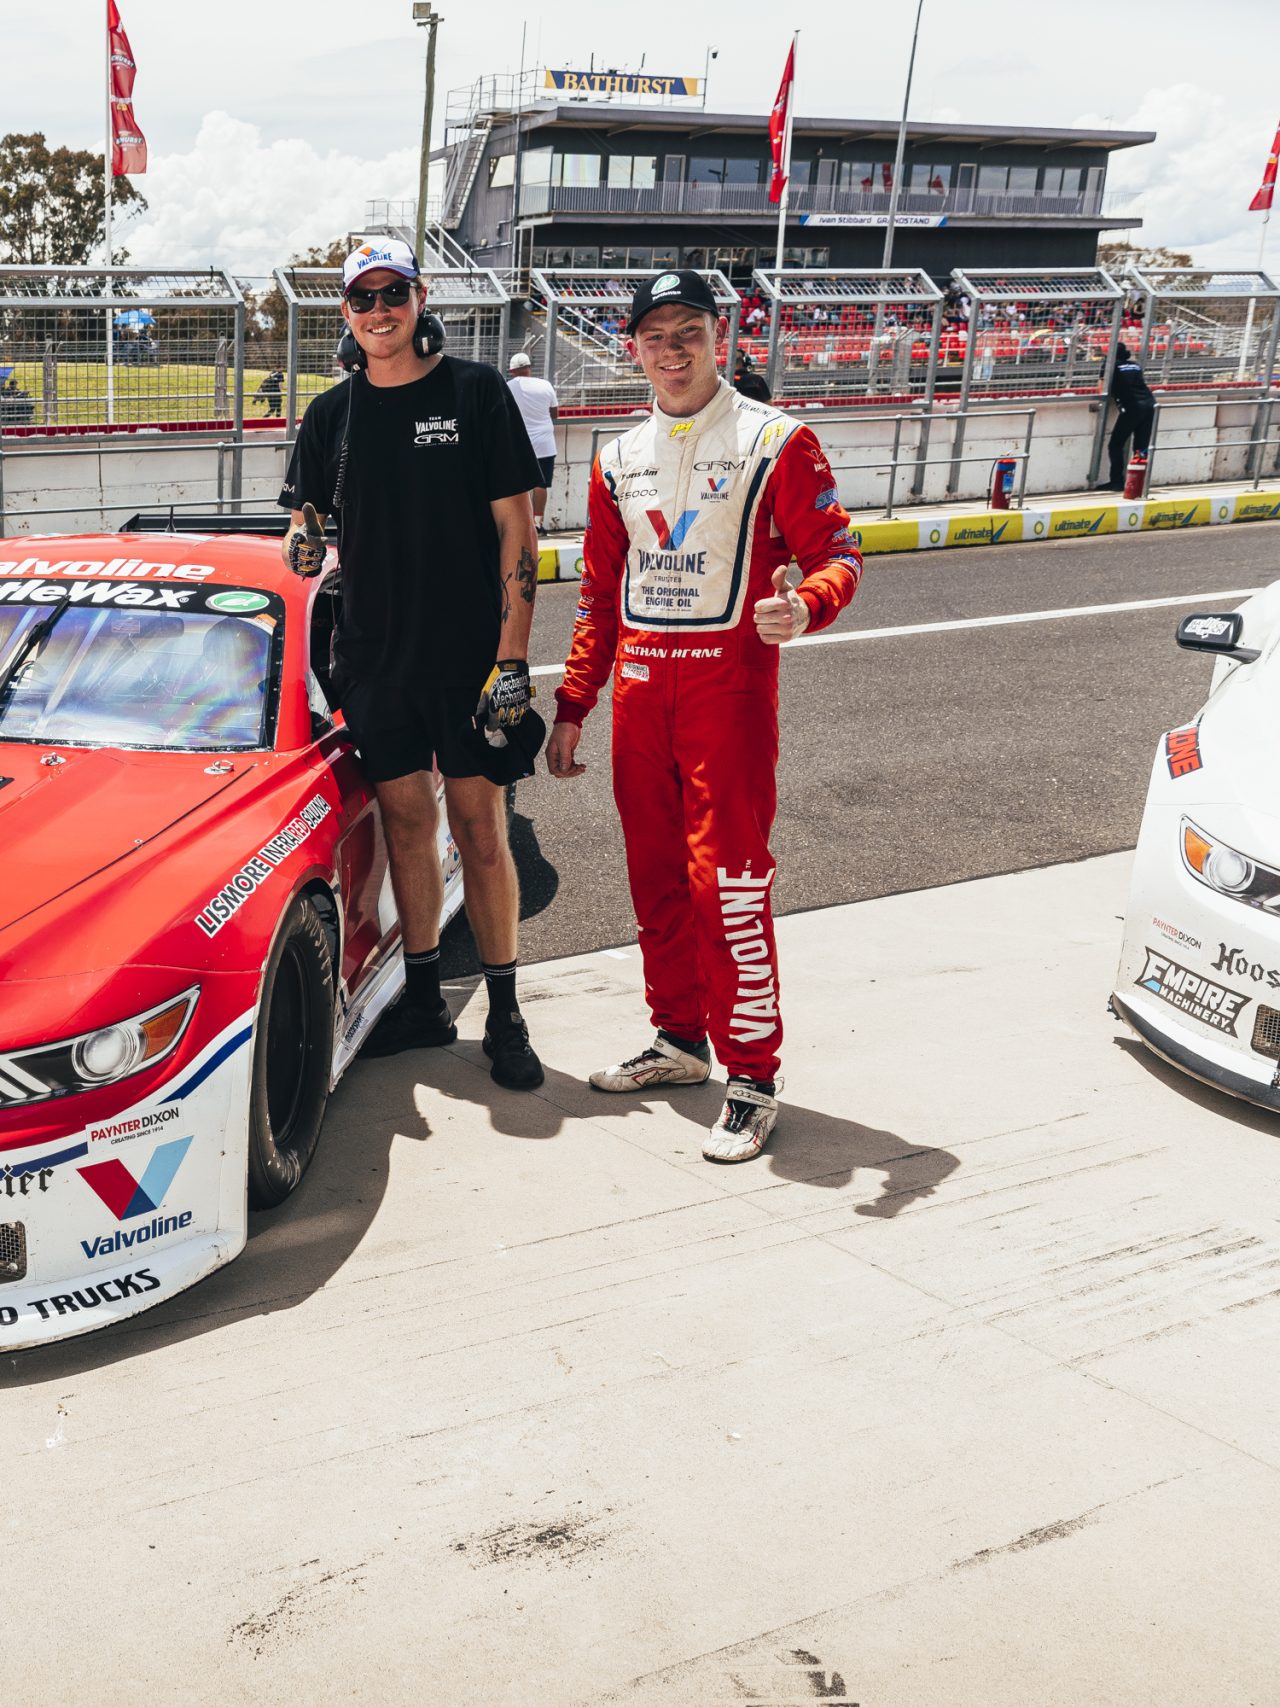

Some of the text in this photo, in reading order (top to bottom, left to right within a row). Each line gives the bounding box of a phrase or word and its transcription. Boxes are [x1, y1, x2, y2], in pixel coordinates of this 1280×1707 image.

[563, 73, 675, 95] BATHURST
[357, 251, 393, 270] VALVOLINE
[415, 418, 458, 434] VALVOLINE
[413, 432, 459, 445] GRM
[693, 460, 746, 472] GRM
[953, 527, 992, 541] ultimate
[1054, 518, 1091, 532] ultimate
[637, 548, 708, 576] VALVOLINE
[641, 585, 700, 598] THE ORIGINAL
[676, 598, 692, 608] OIL
[623, 643, 668, 659] NATHAN
[195, 794, 331, 936] LISMORE INFRARED SAUNA
[1152, 916, 1179, 937] PAYNTER
[1178, 930, 1202, 950] DIXON
[716, 866, 778, 1043] VALVOLINE
[1139, 950, 1245, 1019] EMPIRE
[91, 1106, 180, 1142] PAYNTER DIXON
[111, 1133, 136, 1145] CREATING
[136, 1129, 151, 1138] SINCE
[80, 1210, 193, 1259] Valvoline
[27, 1268, 162, 1321] TRUCKS
